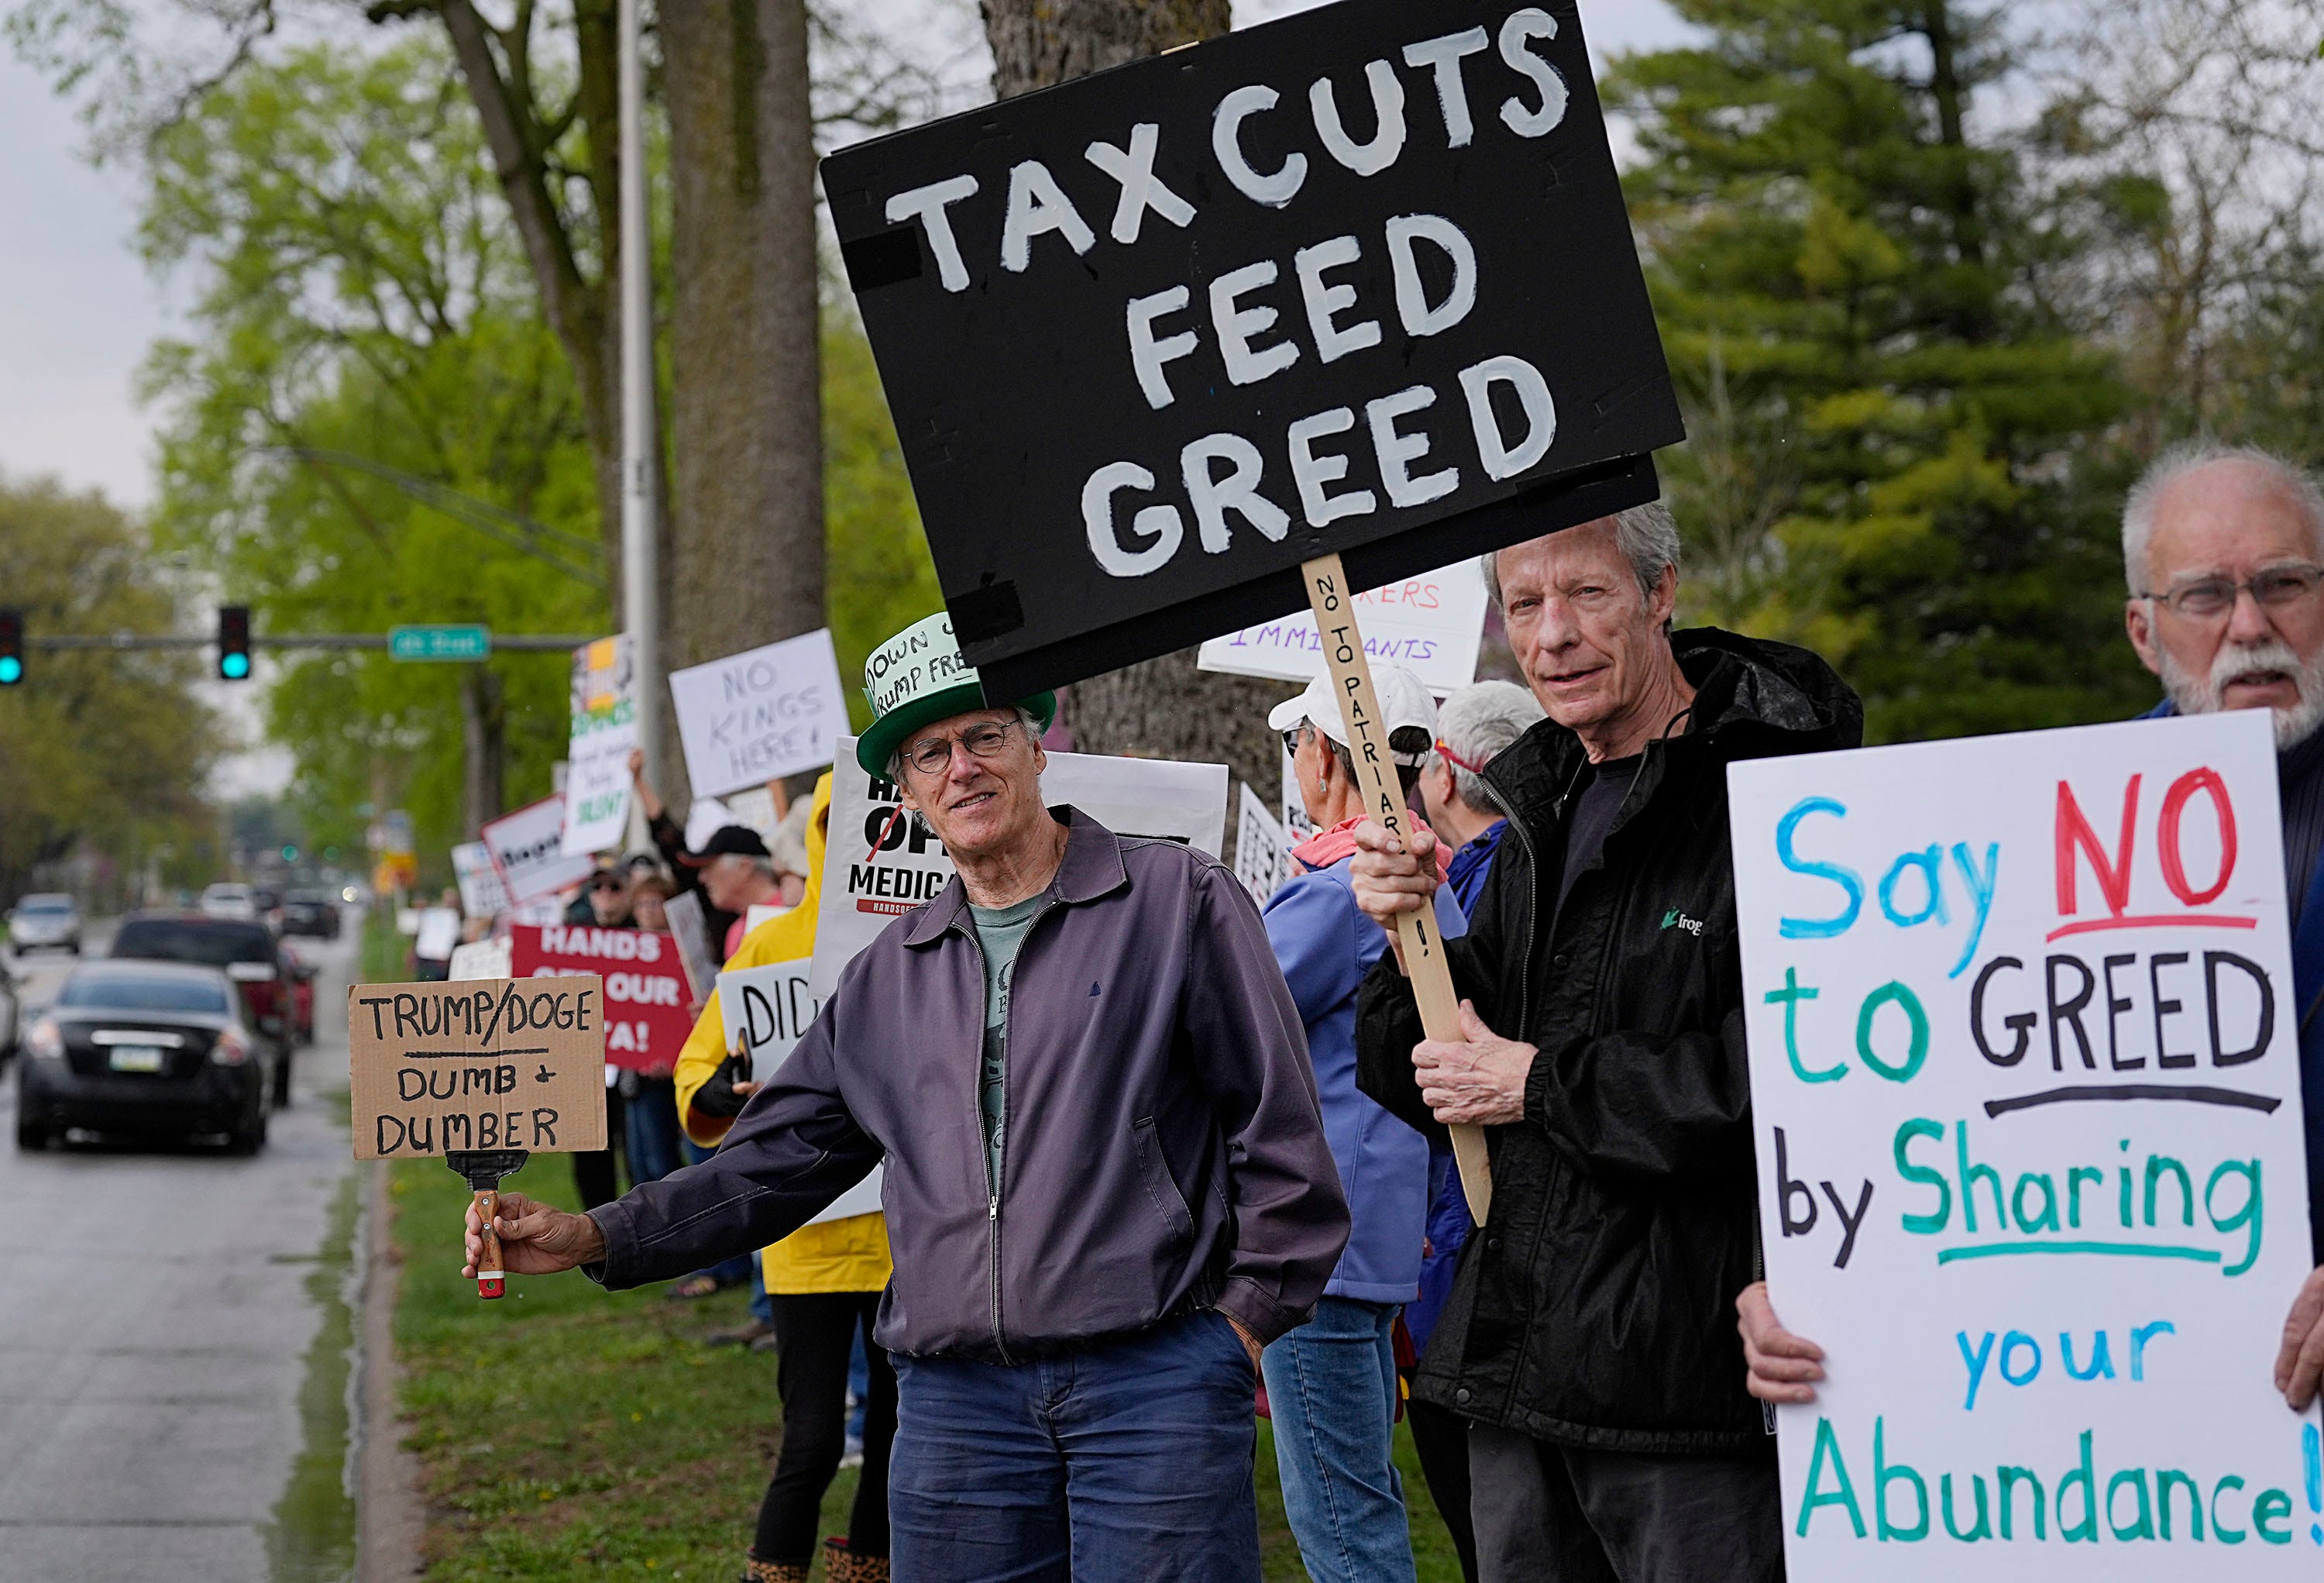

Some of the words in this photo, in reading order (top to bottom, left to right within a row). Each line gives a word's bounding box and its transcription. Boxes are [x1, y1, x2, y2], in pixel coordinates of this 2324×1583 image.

[885, 122, 1198, 293] TAX
[1212, 7, 1569, 209] CUTS
[1126, 212, 1478, 411] FEED
[1081, 355, 1558, 578] GREED
[867, 631, 928, 696] DOWN
[1229, 625, 1439, 659] IMMIANTS
[722, 660, 776, 702] NO
[877, 666, 921, 716] RUMP
[929, 650, 967, 683] FRE
[708, 685, 824, 750] KINGS
[728, 724, 821, 779] HERE!
[1317, 575, 1339, 611] NO
[1331, 626, 1353, 663] TO
[1344, 676, 1429, 957] PATRIAR!
[848, 864, 955, 900] MEDIC
[1776, 796, 1999, 979] Say
[2055, 766, 2238, 918] NO
[873, 902, 915, 914] HANDSOF
[541, 927, 661, 962] HANDS
[359, 982, 593, 1046] TRUMP/DOGE
[606, 972, 680, 1006] OUR
[1764, 967, 1930, 1084] to
[1970, 951, 2275, 1072] GREED
[397, 1065, 516, 1102] DUMB
[376, 1108, 559, 1155] DUMBER
[1774, 1126, 1874, 1269] by
[1893, 1117, 2264, 1277] Sharing
[1956, 1320, 2176, 1411] your
[1795, 1415, 2324, 1547] Abundance!
